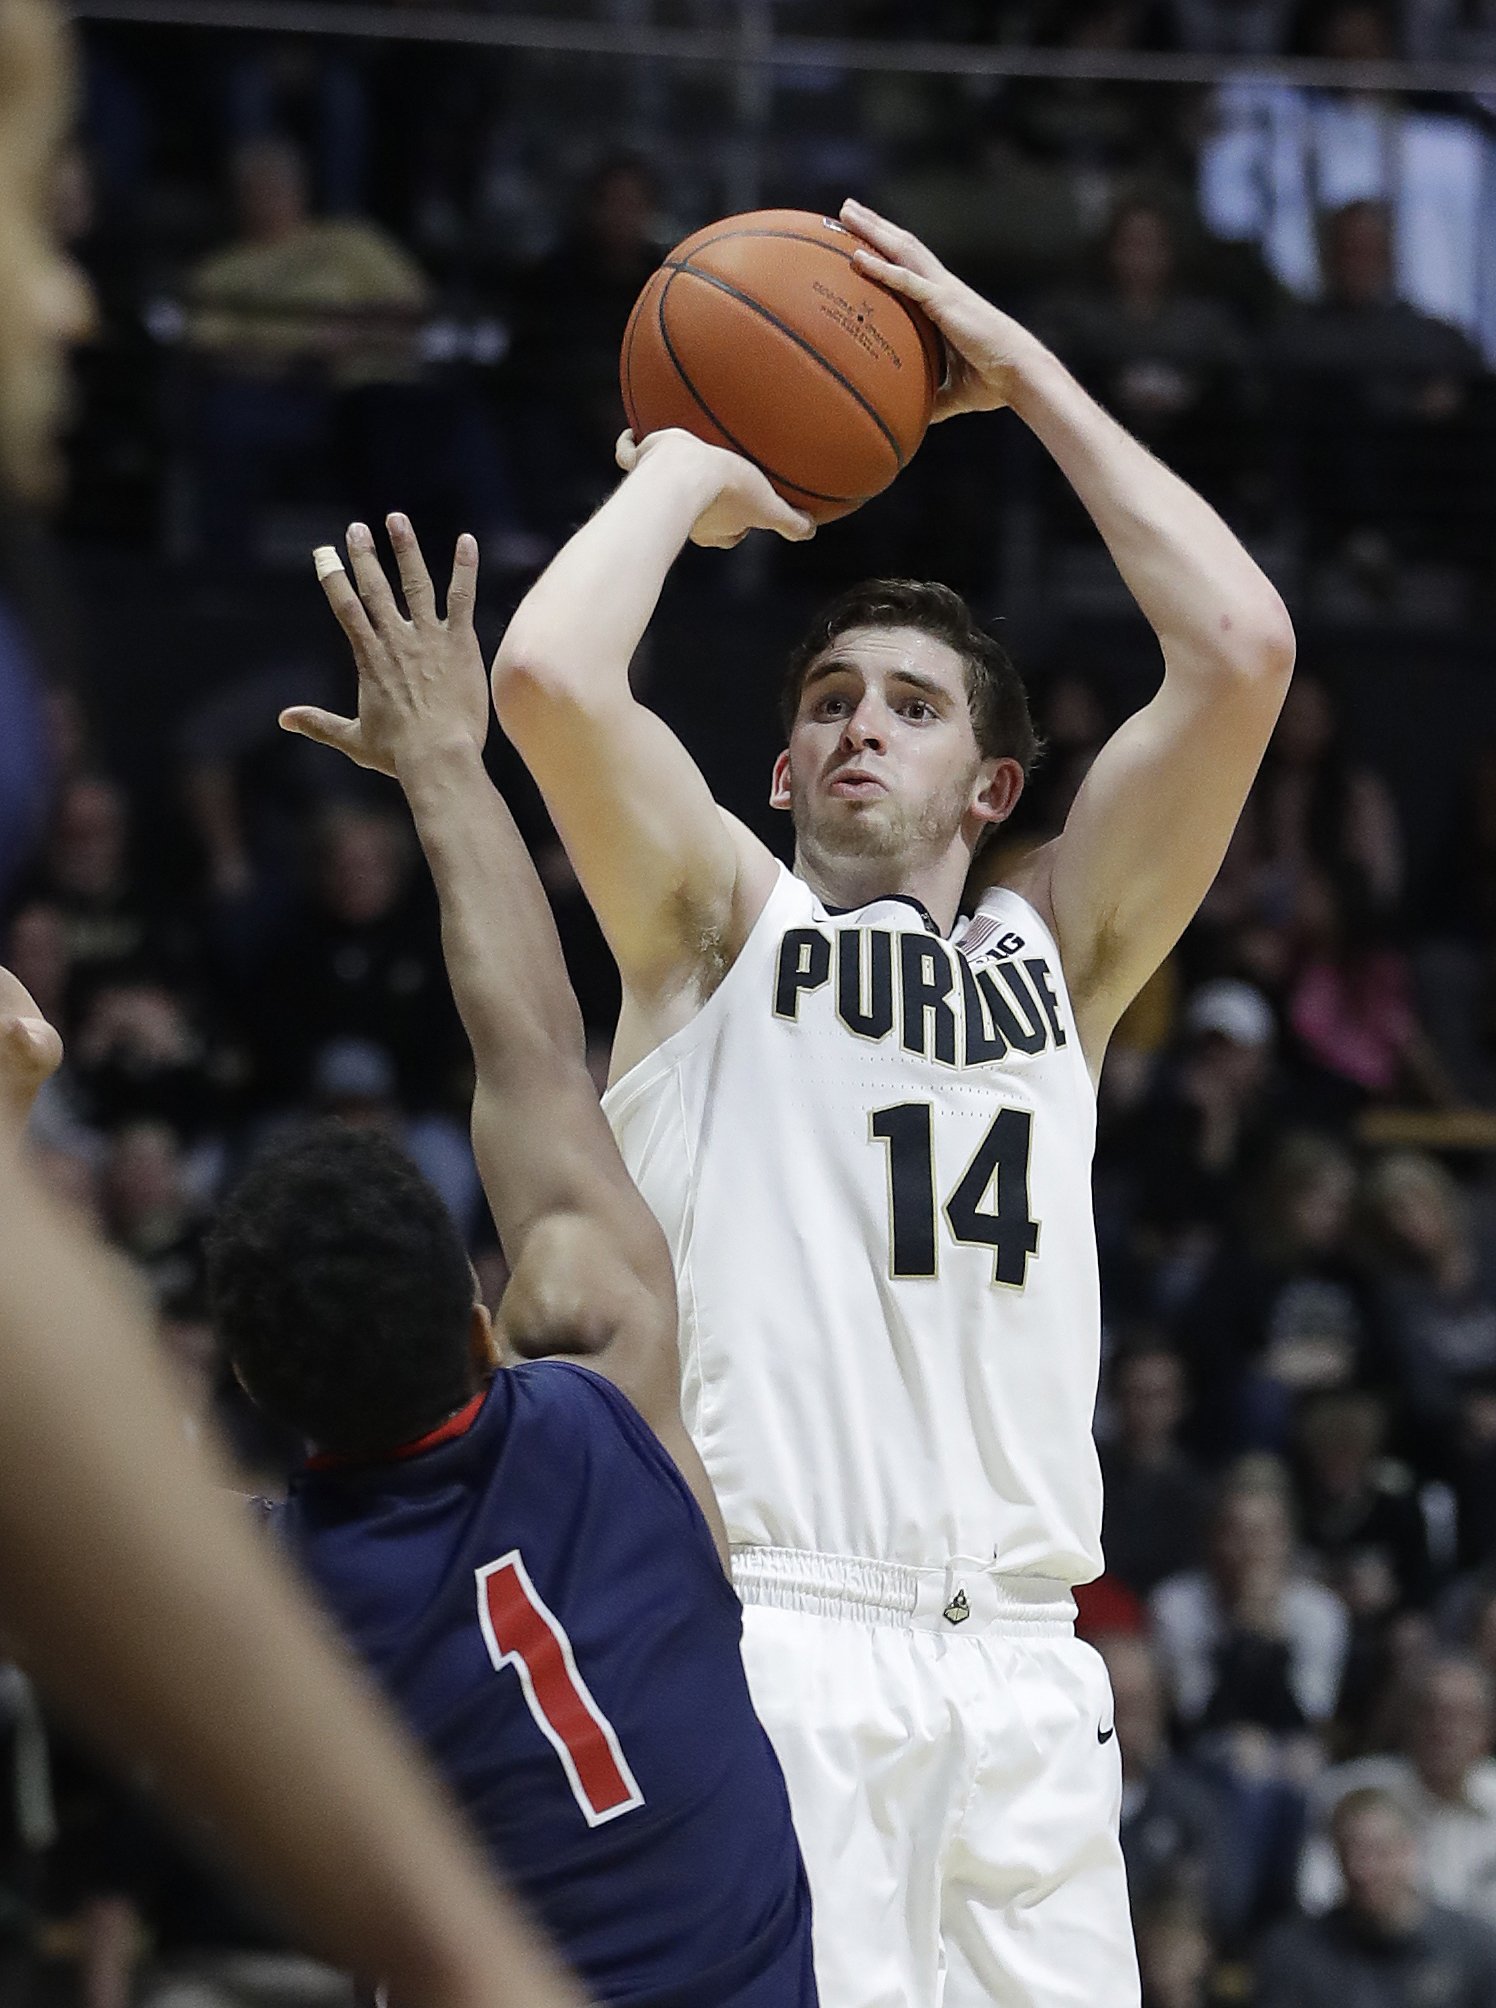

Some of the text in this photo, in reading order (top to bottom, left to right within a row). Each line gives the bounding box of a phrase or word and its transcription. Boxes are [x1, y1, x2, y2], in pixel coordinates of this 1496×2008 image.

[772, 927, 1066, 1070] PURDUE
[868, 1101, 1042, 1290] 14
[475, 1549, 645, 1828] 1
